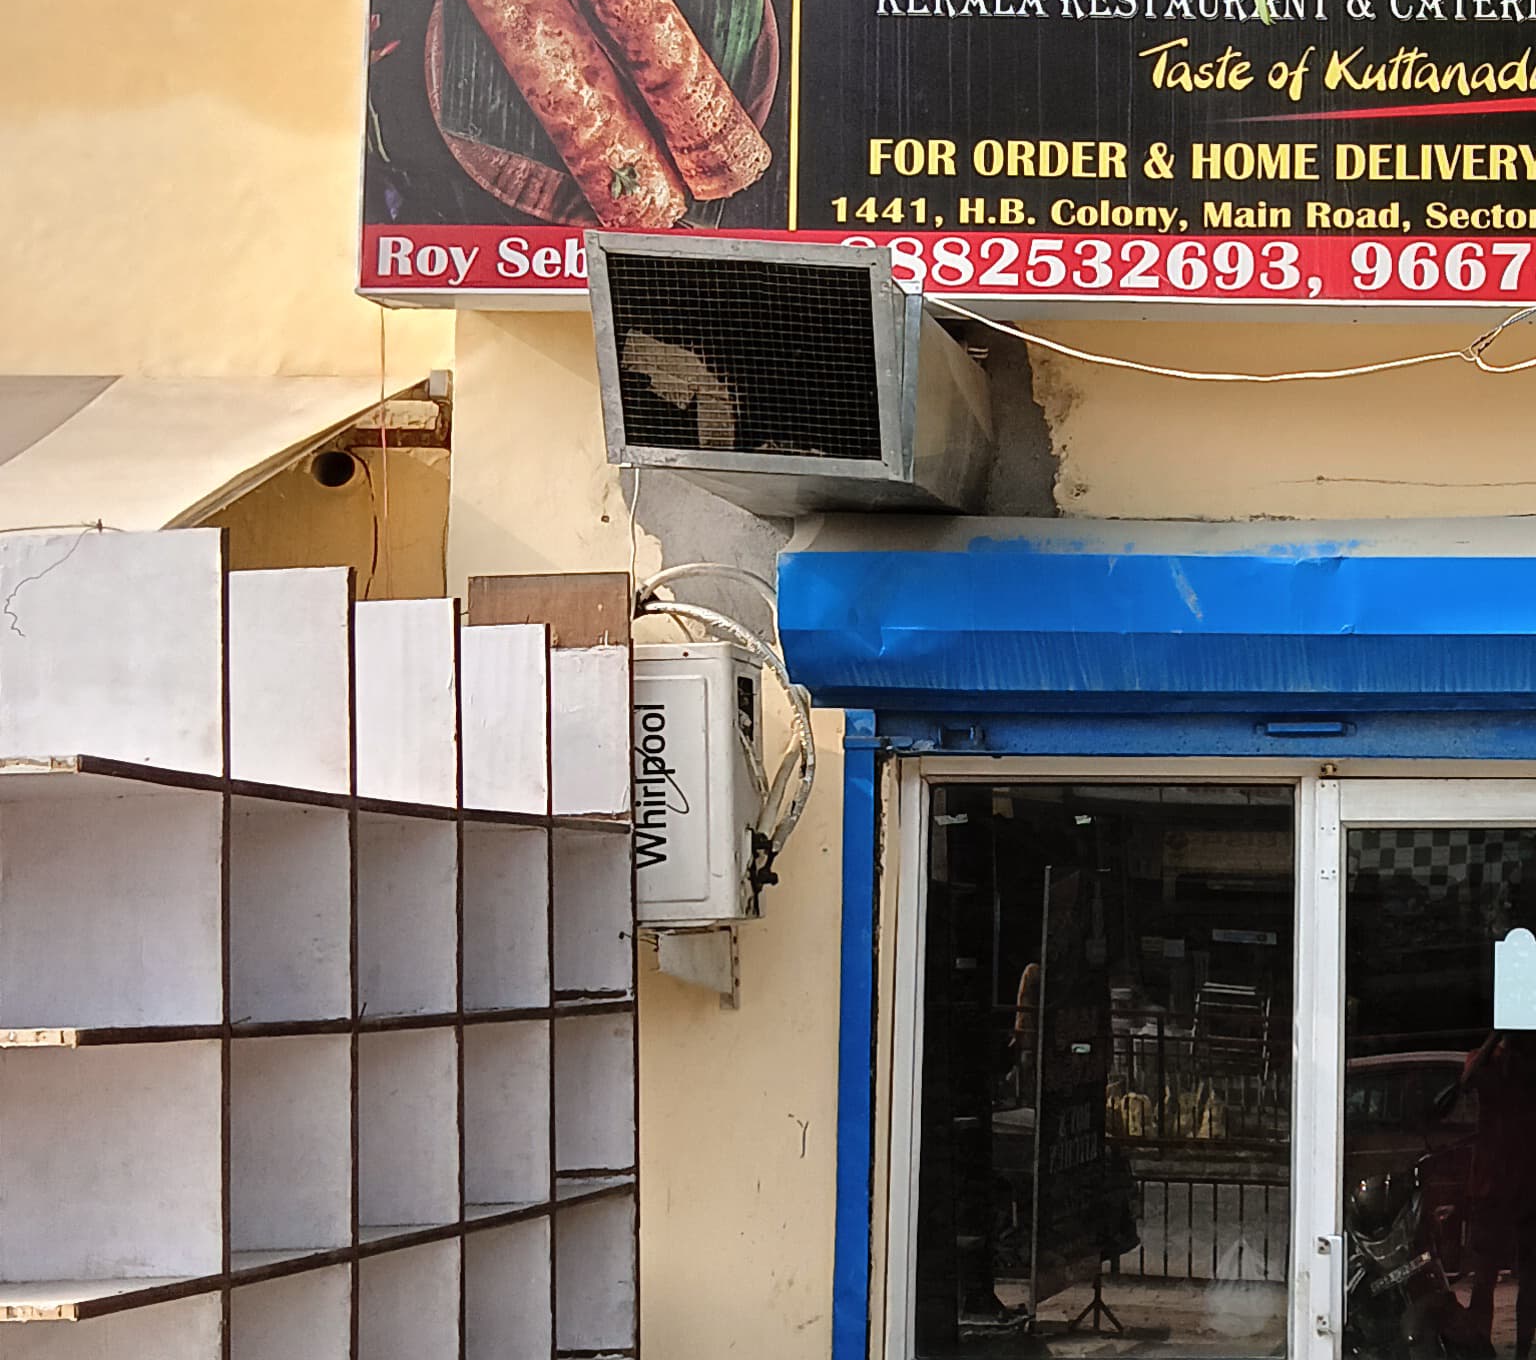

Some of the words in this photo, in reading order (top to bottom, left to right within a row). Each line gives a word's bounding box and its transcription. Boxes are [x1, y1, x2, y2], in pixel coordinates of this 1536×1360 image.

[1139, 38, 1254, 92] Taste
[1267, 45, 1316, 101] of
[870, 138, 957, 176] FOR
[973, 138, 1127, 179] ORDER
[1144, 142, 1177, 180] &
[1192, 143, 1320, 181] HOME
[832, 197, 943, 228] 1441,
[959, 197, 1035, 225] H.B.
[1051, 198, 1188, 233] Colony,
[1203, 201, 1295, 229] Main
[1307, 201, 1411, 232] Road,
[377, 236, 479, 286] Roy
[496, 237, 588, 278] Seb
[841, 236, 1322, 297] 882532693,
[634, 704, 677, 870] Whirlpool
